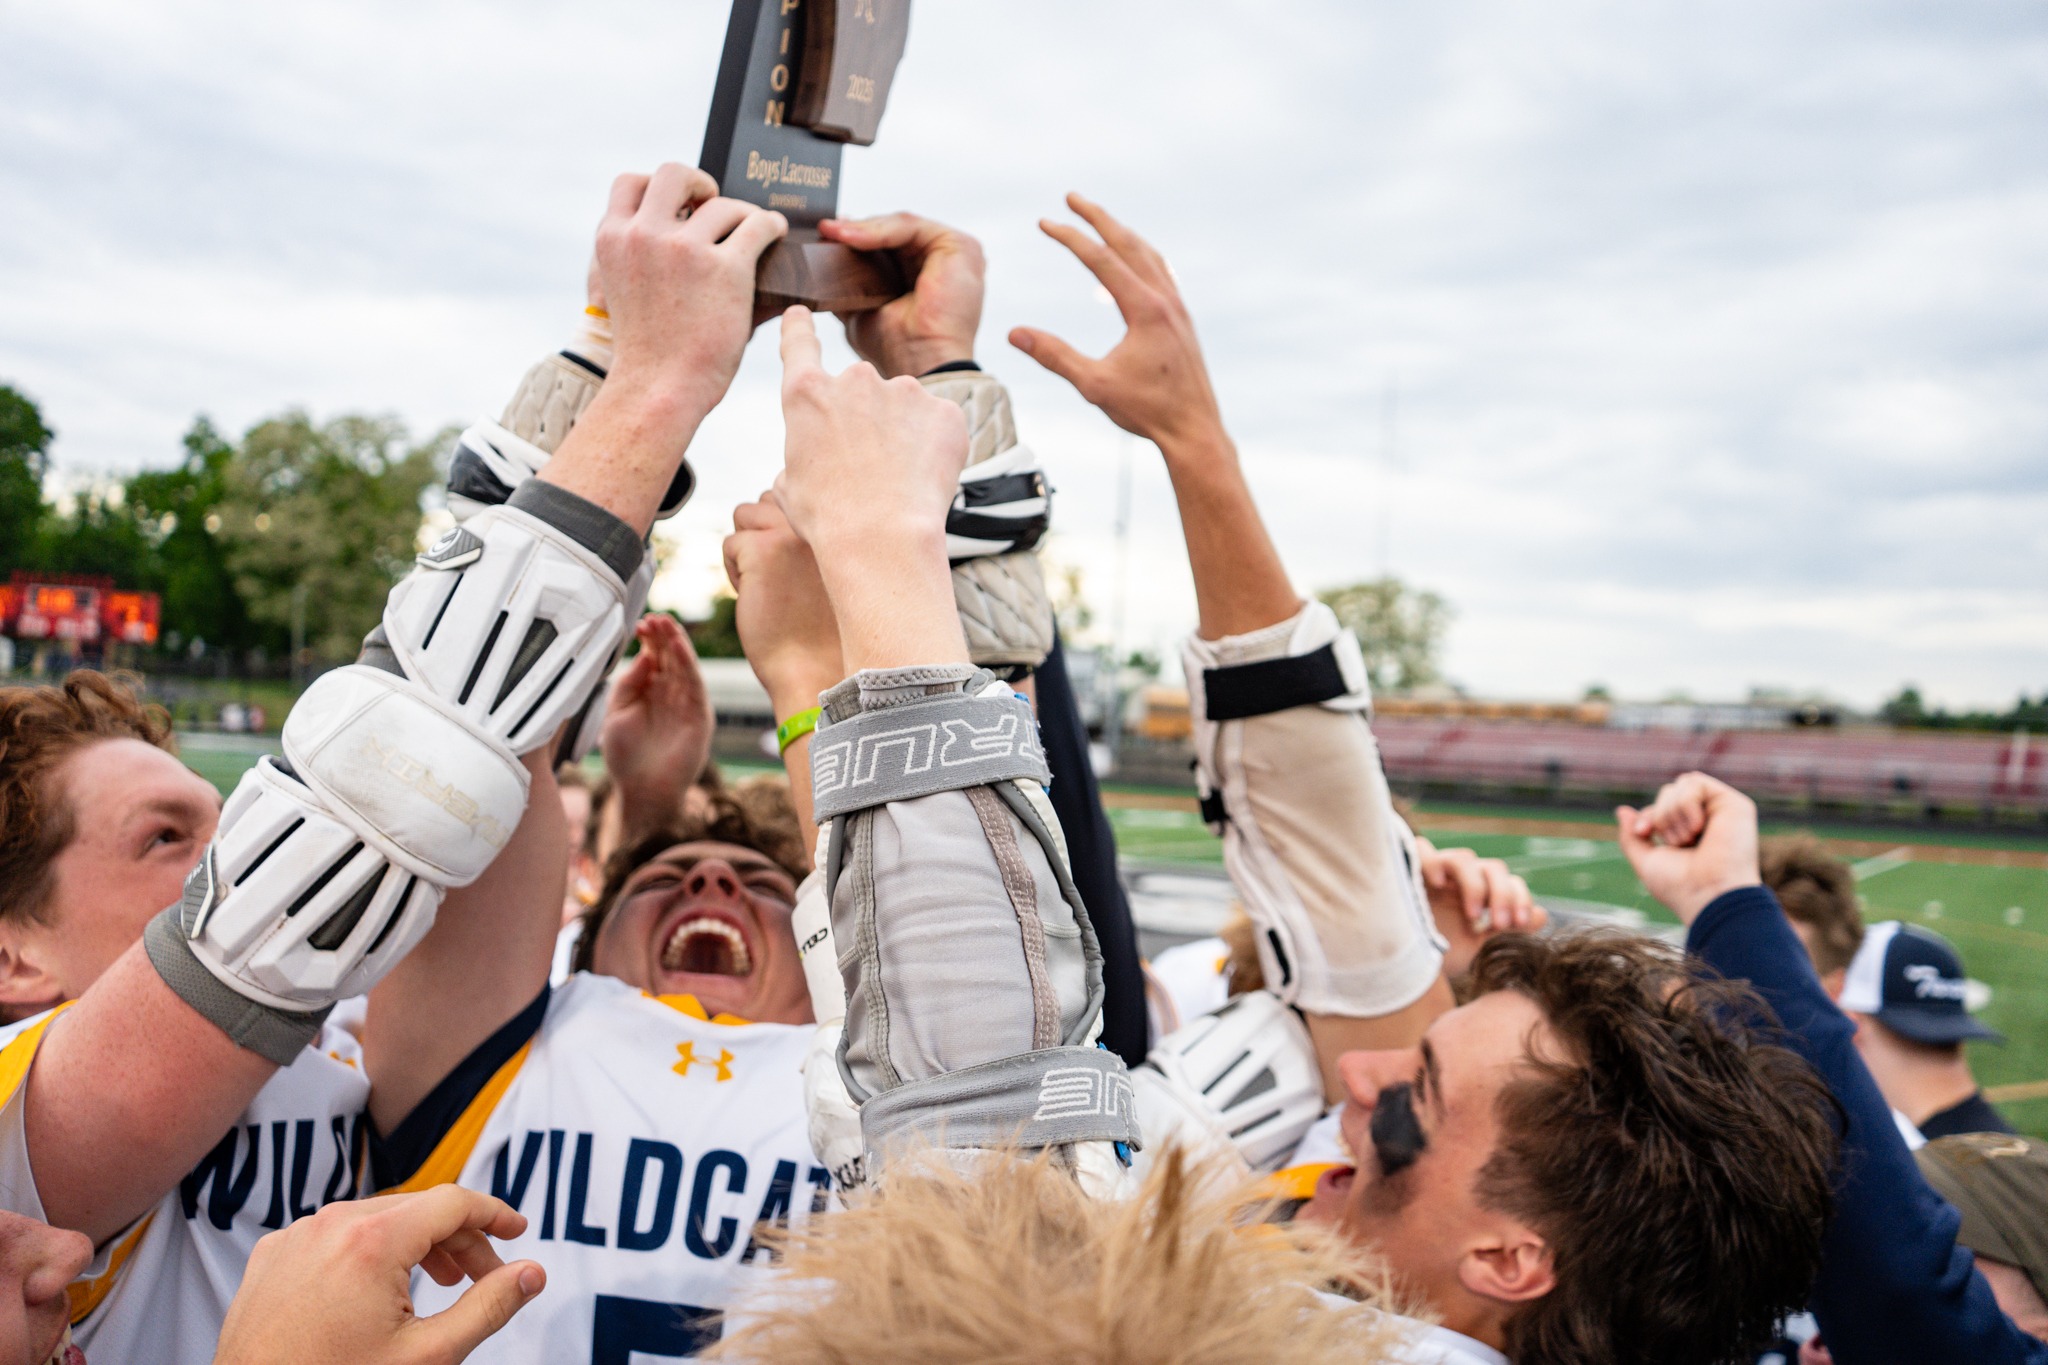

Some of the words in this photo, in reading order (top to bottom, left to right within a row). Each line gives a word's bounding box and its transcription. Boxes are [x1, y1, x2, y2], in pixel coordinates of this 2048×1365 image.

[746, 150, 781, 189] Boys
[780, 155, 832, 190] Lacrosse
[814, 714, 1046, 799] TRUE
